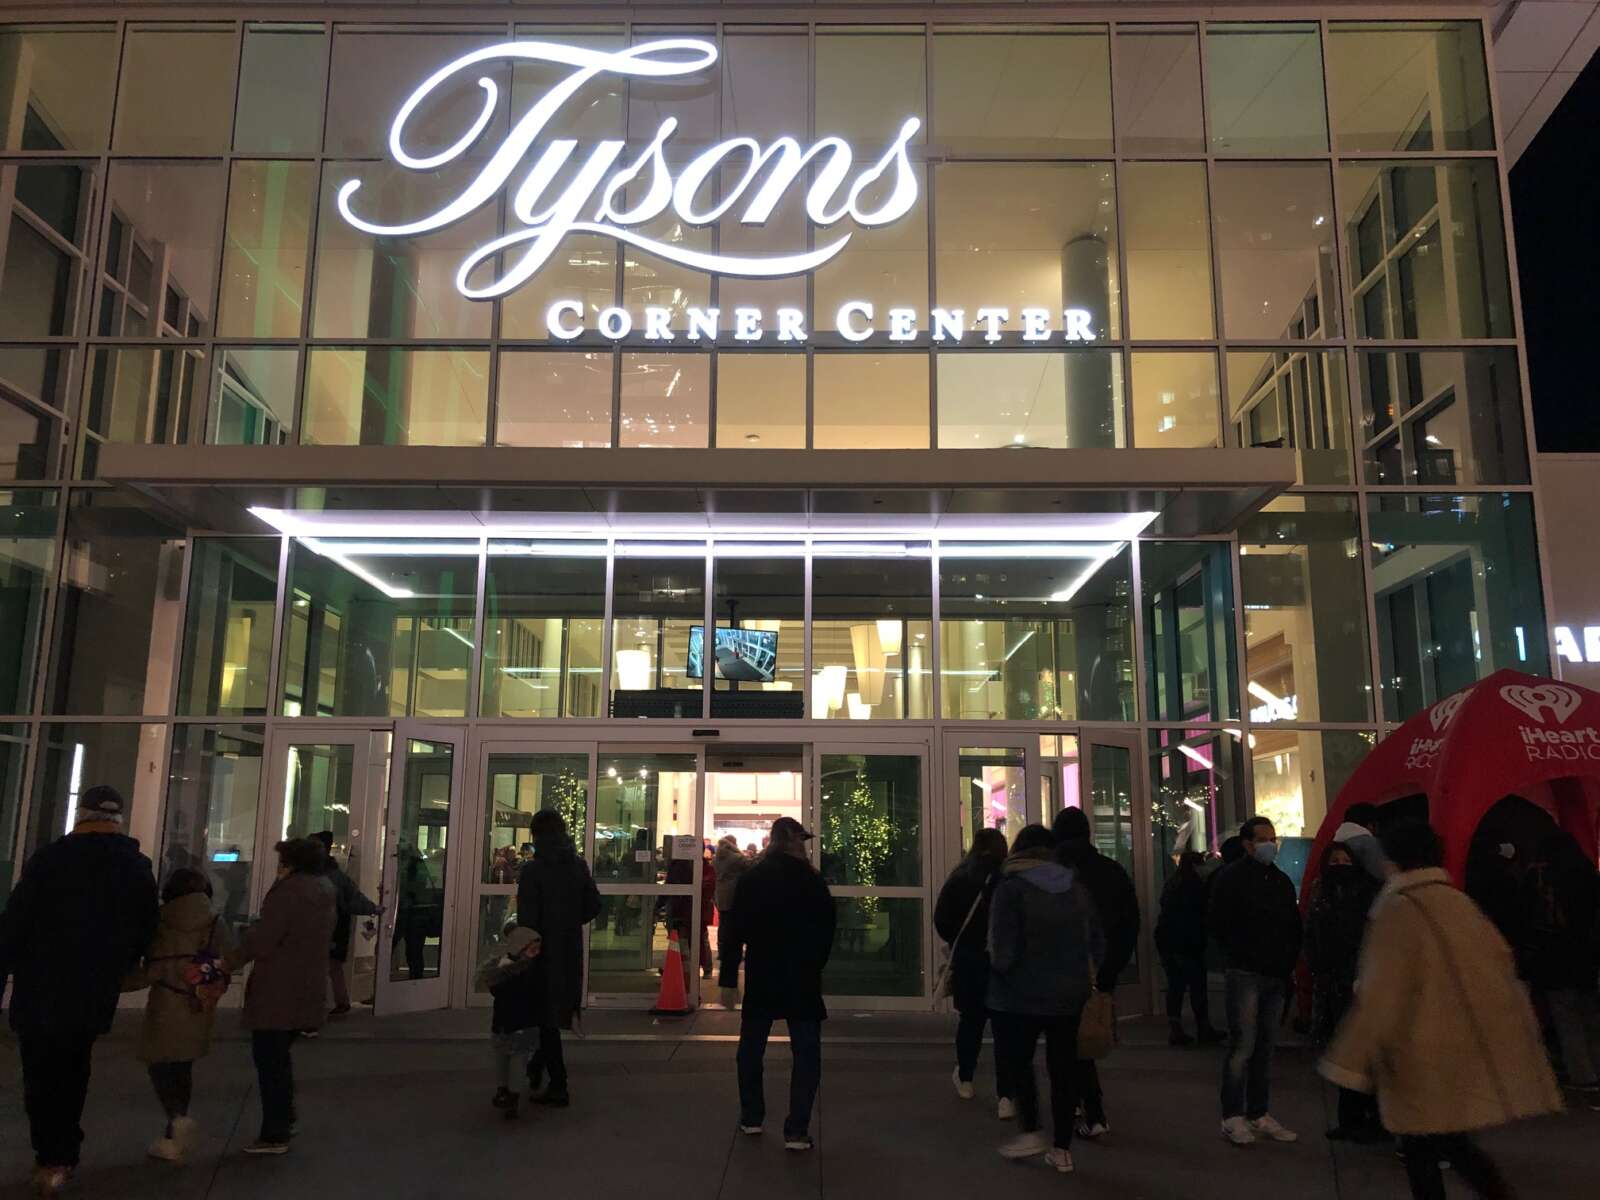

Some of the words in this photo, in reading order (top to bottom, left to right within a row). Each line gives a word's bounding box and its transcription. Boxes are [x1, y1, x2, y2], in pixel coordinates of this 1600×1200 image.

[337, 38, 921, 299] Tysons
[545, 299, 809, 342] CORNER
[835, 299, 1098, 342] CENTER
[1518, 725, 1600, 744] iHeart
